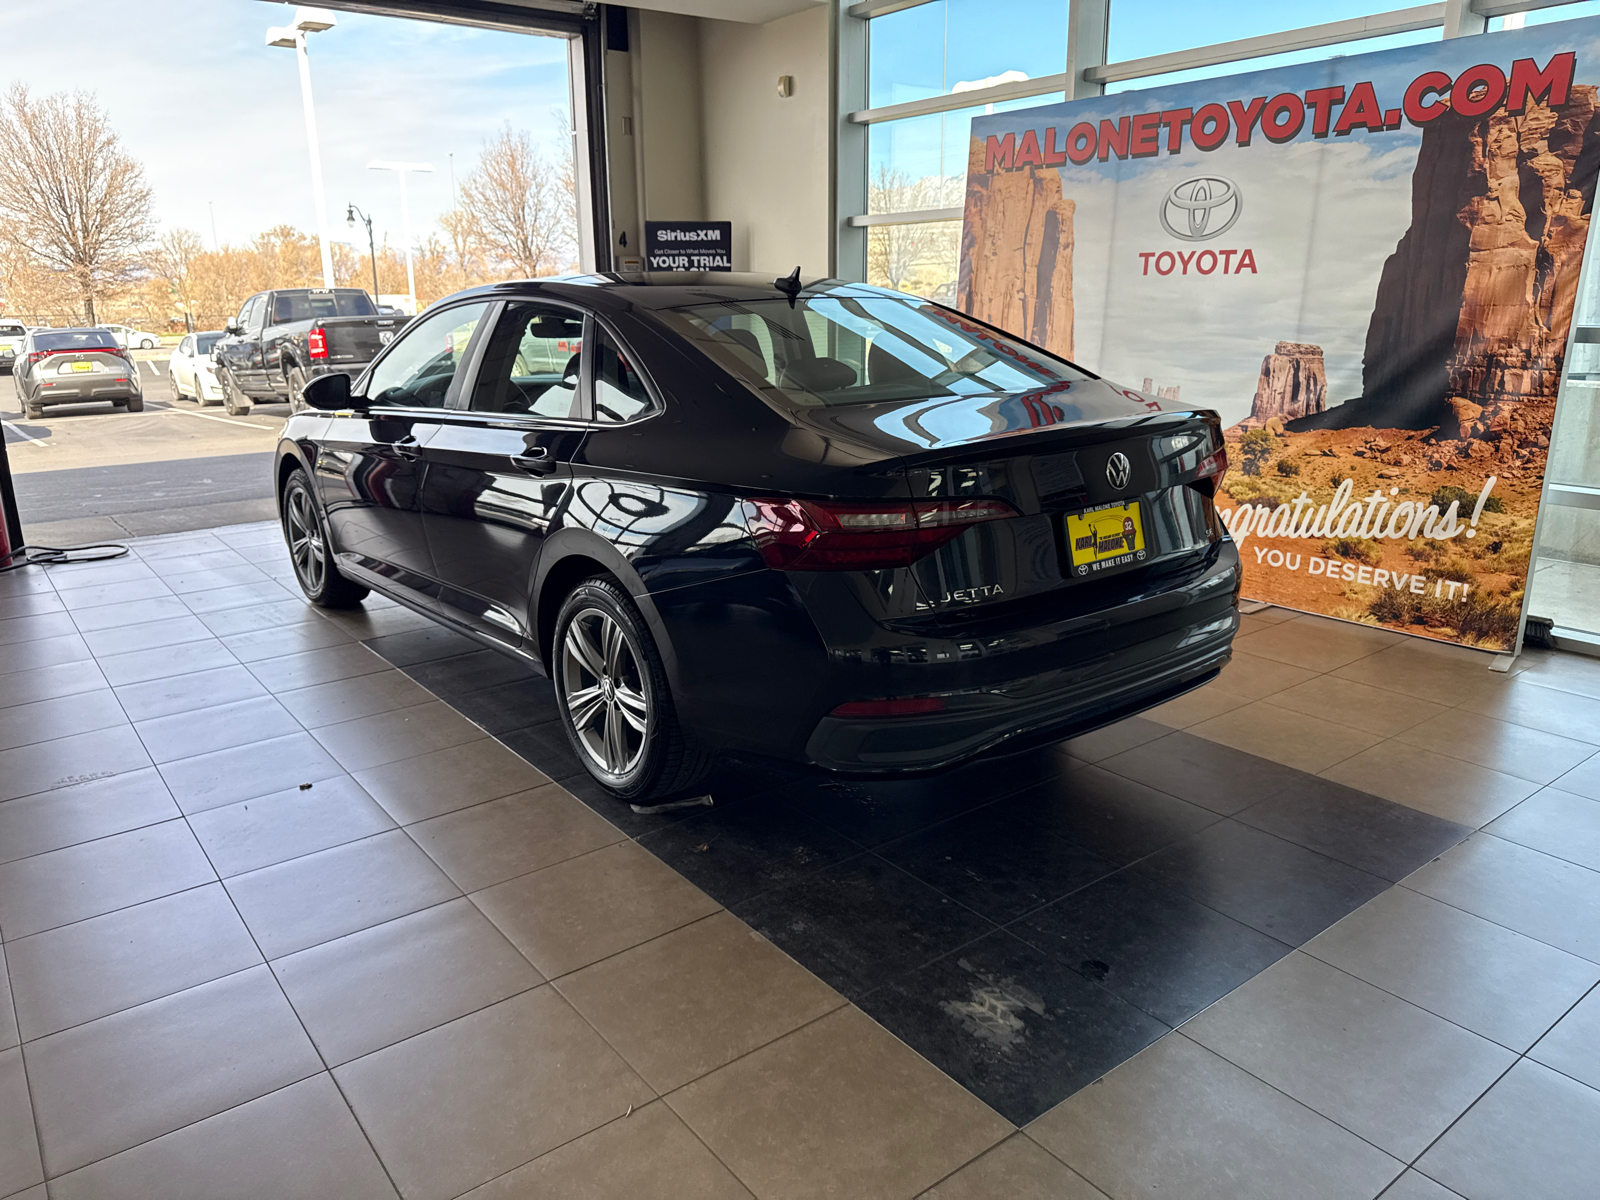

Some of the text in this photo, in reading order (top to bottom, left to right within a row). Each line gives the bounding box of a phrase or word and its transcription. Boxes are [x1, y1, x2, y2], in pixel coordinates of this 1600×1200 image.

[983, 51, 1576, 174] MALONETOYOTA.COM
[619, 231, 627, 248] 4
[657, 229, 721, 241] SiriusXM
[650, 256, 689, 268] YOUR
[691, 256, 731, 267] TRIAL
[1138, 248, 1259, 276] TOYOTA
[1214, 476, 1497, 550] ngratulations!
[1124, 521, 1133, 531] 32
[1075, 535, 1093, 551] KARL
[1098, 536, 1124, 554] MALONE
[1092, 554, 1134, 571] WE MAKE IT EASY
[1253, 546, 1469, 603] YOU DESERVE IT!
[940, 583, 1004, 602] JETTA
